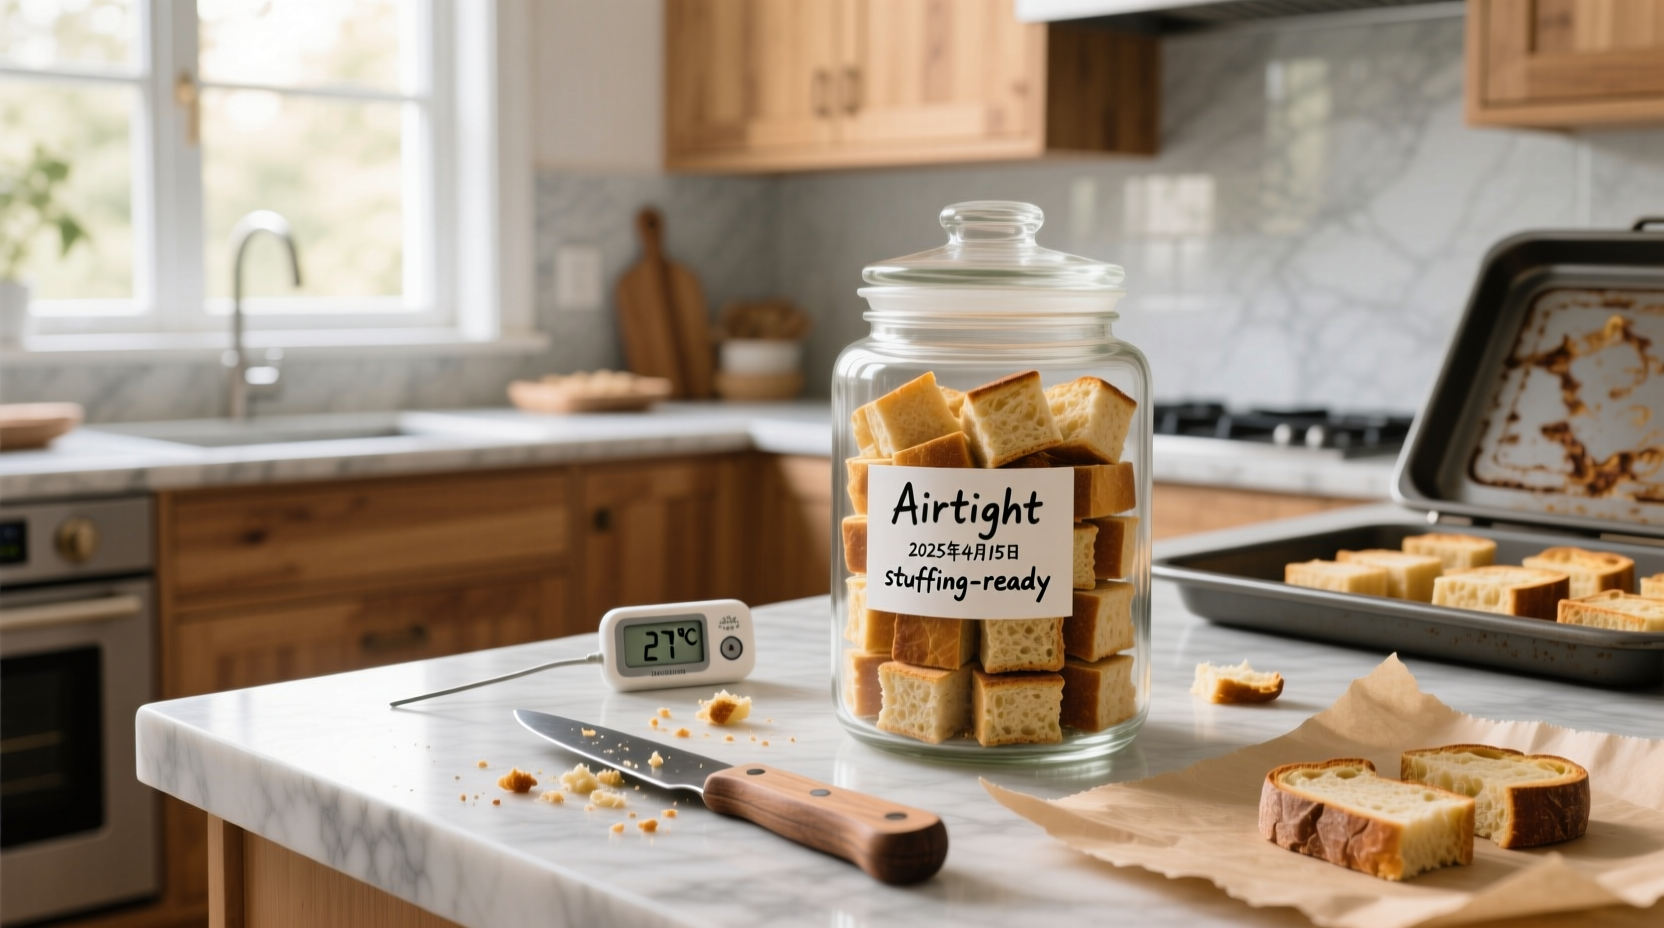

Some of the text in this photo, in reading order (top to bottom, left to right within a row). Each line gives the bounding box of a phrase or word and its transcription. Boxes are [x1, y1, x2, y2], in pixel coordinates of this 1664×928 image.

[891, 481, 1044, 540] Airtight
[908, 540, 1019, 562] 2025年4月15日
[884, 565, 1051, 603] stuffing-ready
